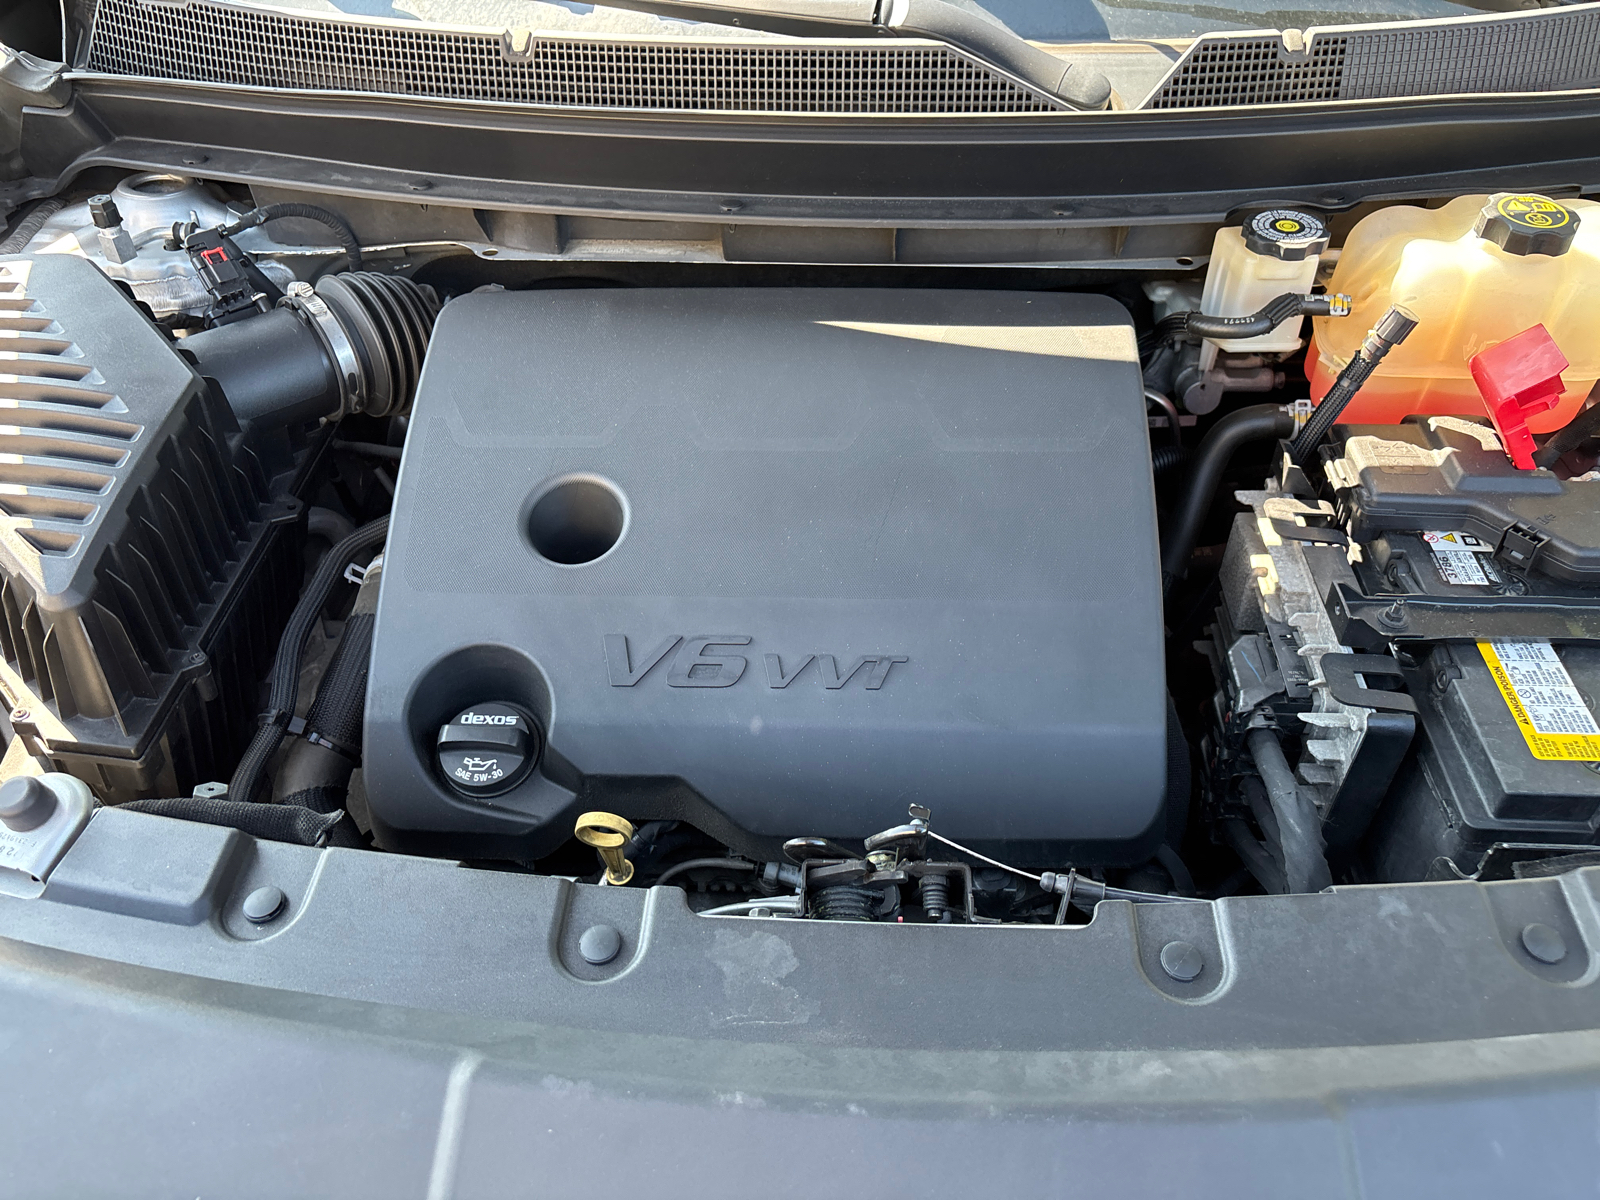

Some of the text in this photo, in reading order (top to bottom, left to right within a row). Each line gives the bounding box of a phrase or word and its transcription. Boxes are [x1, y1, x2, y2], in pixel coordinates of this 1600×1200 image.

[1439, 556, 1458, 579] 3786
[603, 633, 909, 690] V6 VVT
[460, 712, 519, 726] dexos
[455, 767, 504, 782] SAE 5W-30
